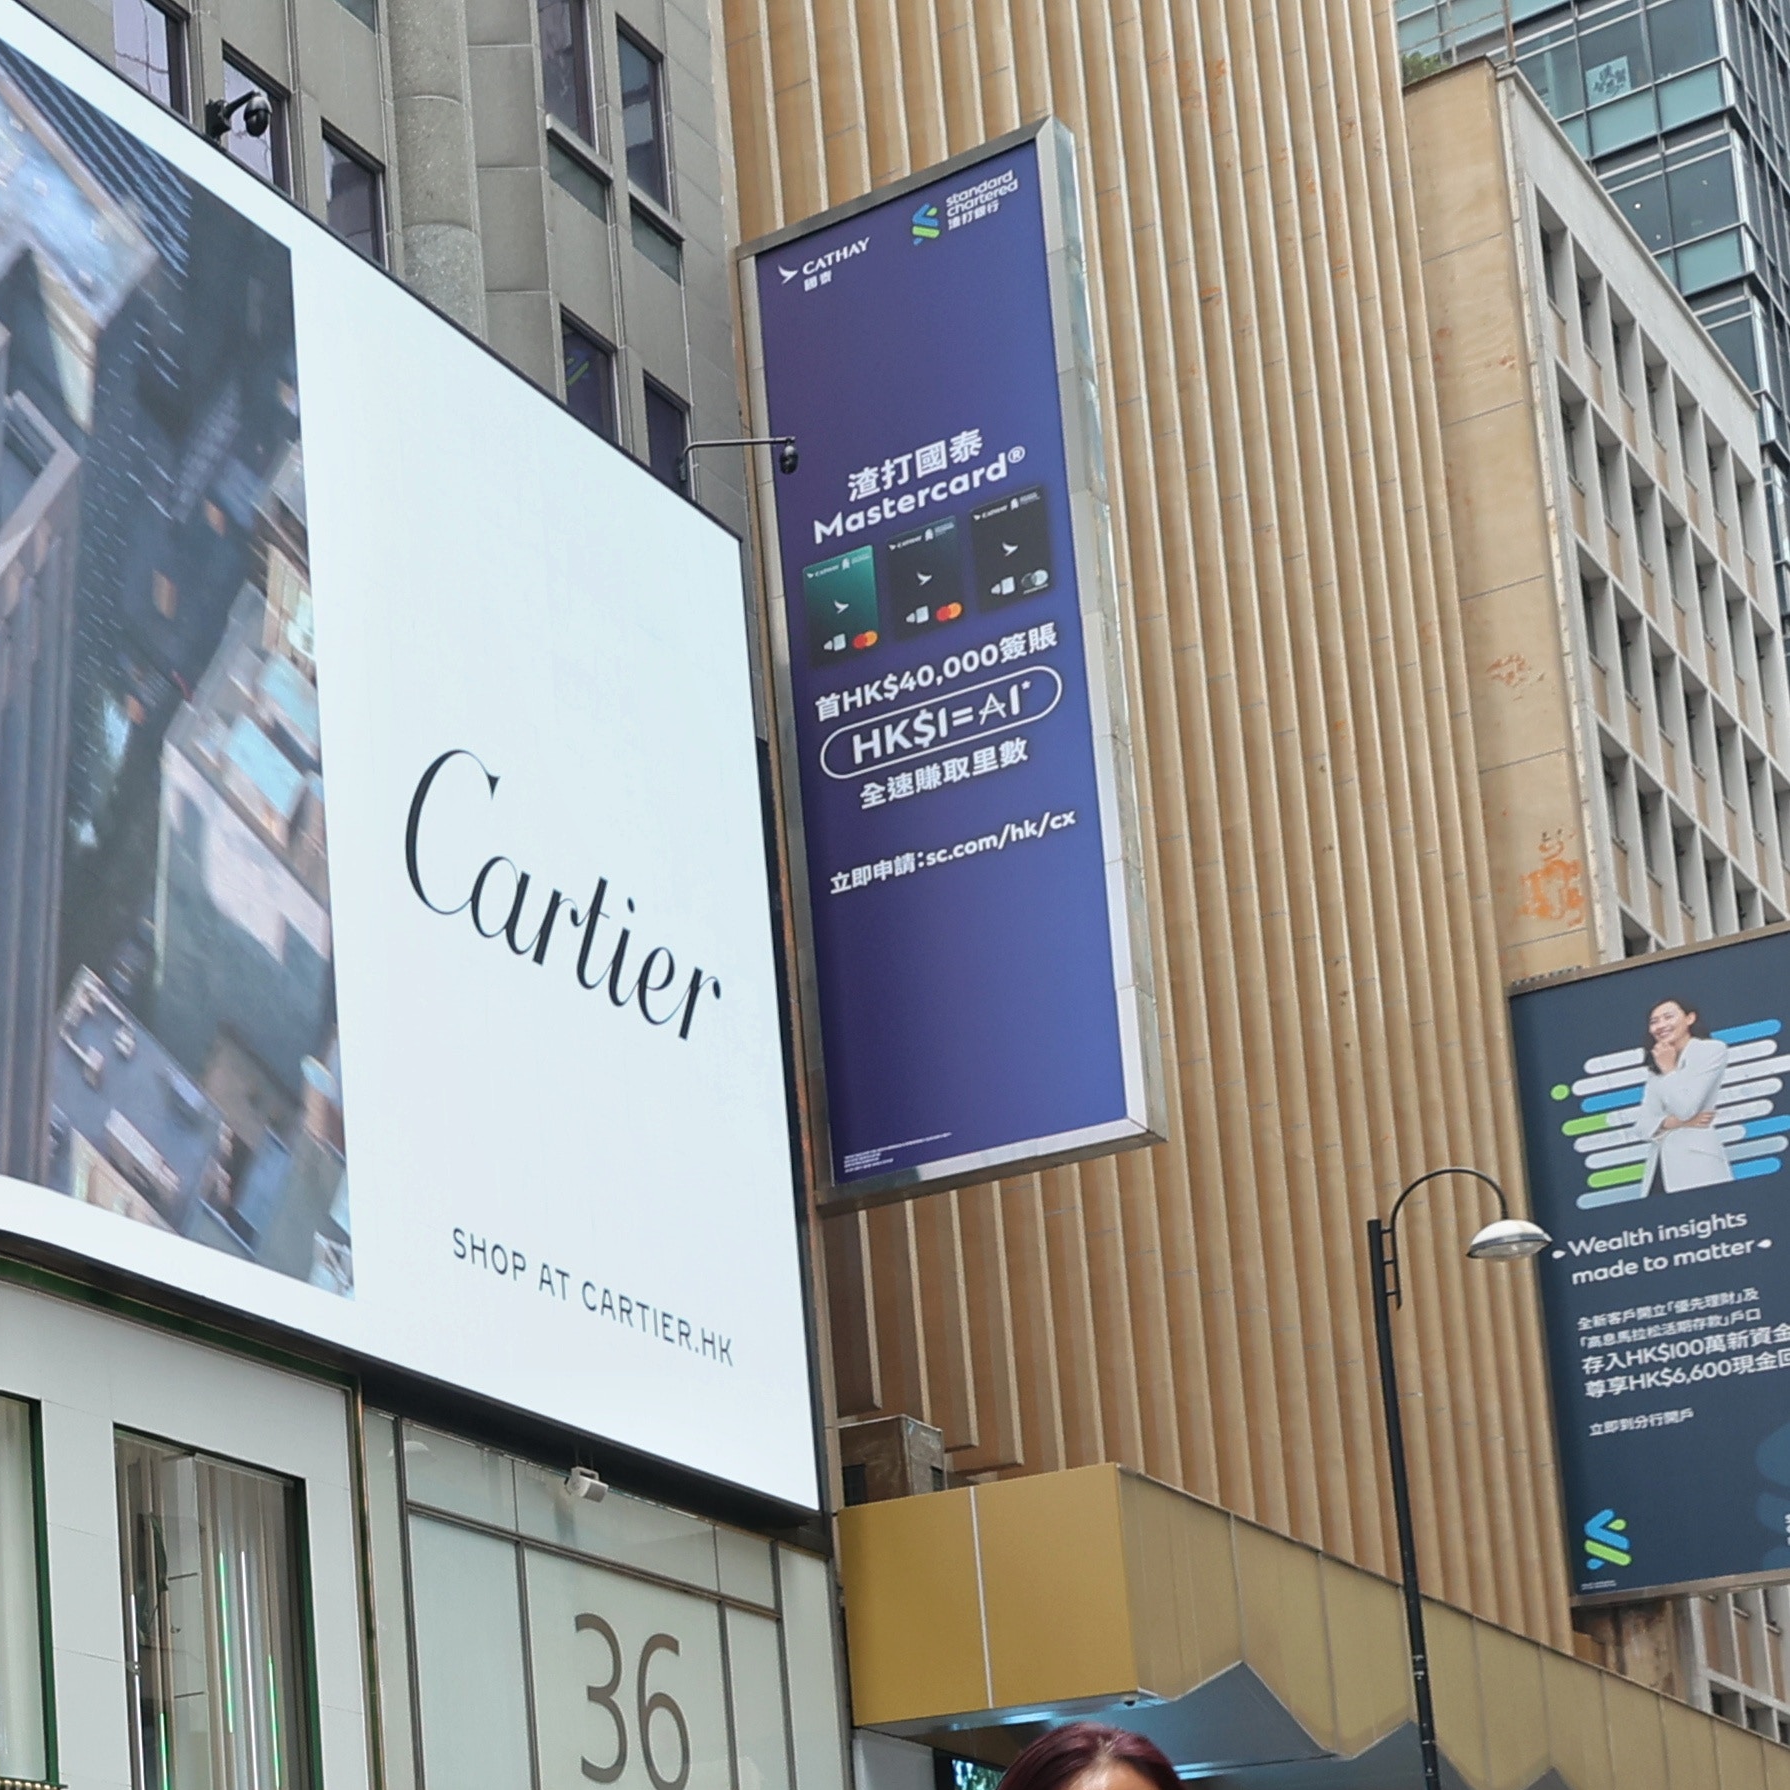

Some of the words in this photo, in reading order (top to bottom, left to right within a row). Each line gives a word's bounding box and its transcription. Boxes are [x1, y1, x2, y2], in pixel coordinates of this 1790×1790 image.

[945, 169, 1013, 207] standard
[946, 178, 1019, 218] chartered
[947, 200, 999, 231] 渣打銀行
[802, 237, 870, 277] CATHAY
[804, 270, 833, 292] 國泰
[847, 427, 984, 503] 渣打國泰
[859, 737, 1029, 809] 全速賺取里數
[404, 748, 721, 1041] Cartier
[1569, 1223, 1654, 1257] Wealth
[1659, 1210, 1748, 1246] insights
[1572, 1255, 1639, 1285] made
[1643, 1252, 1669, 1272] to
[1674, 1237, 1756, 1269] matter
[452, 1226, 527, 1281] SHOP
[538, 1262, 570, 1302] AT
[581, 1281, 735, 1367] CARTIER.HK
